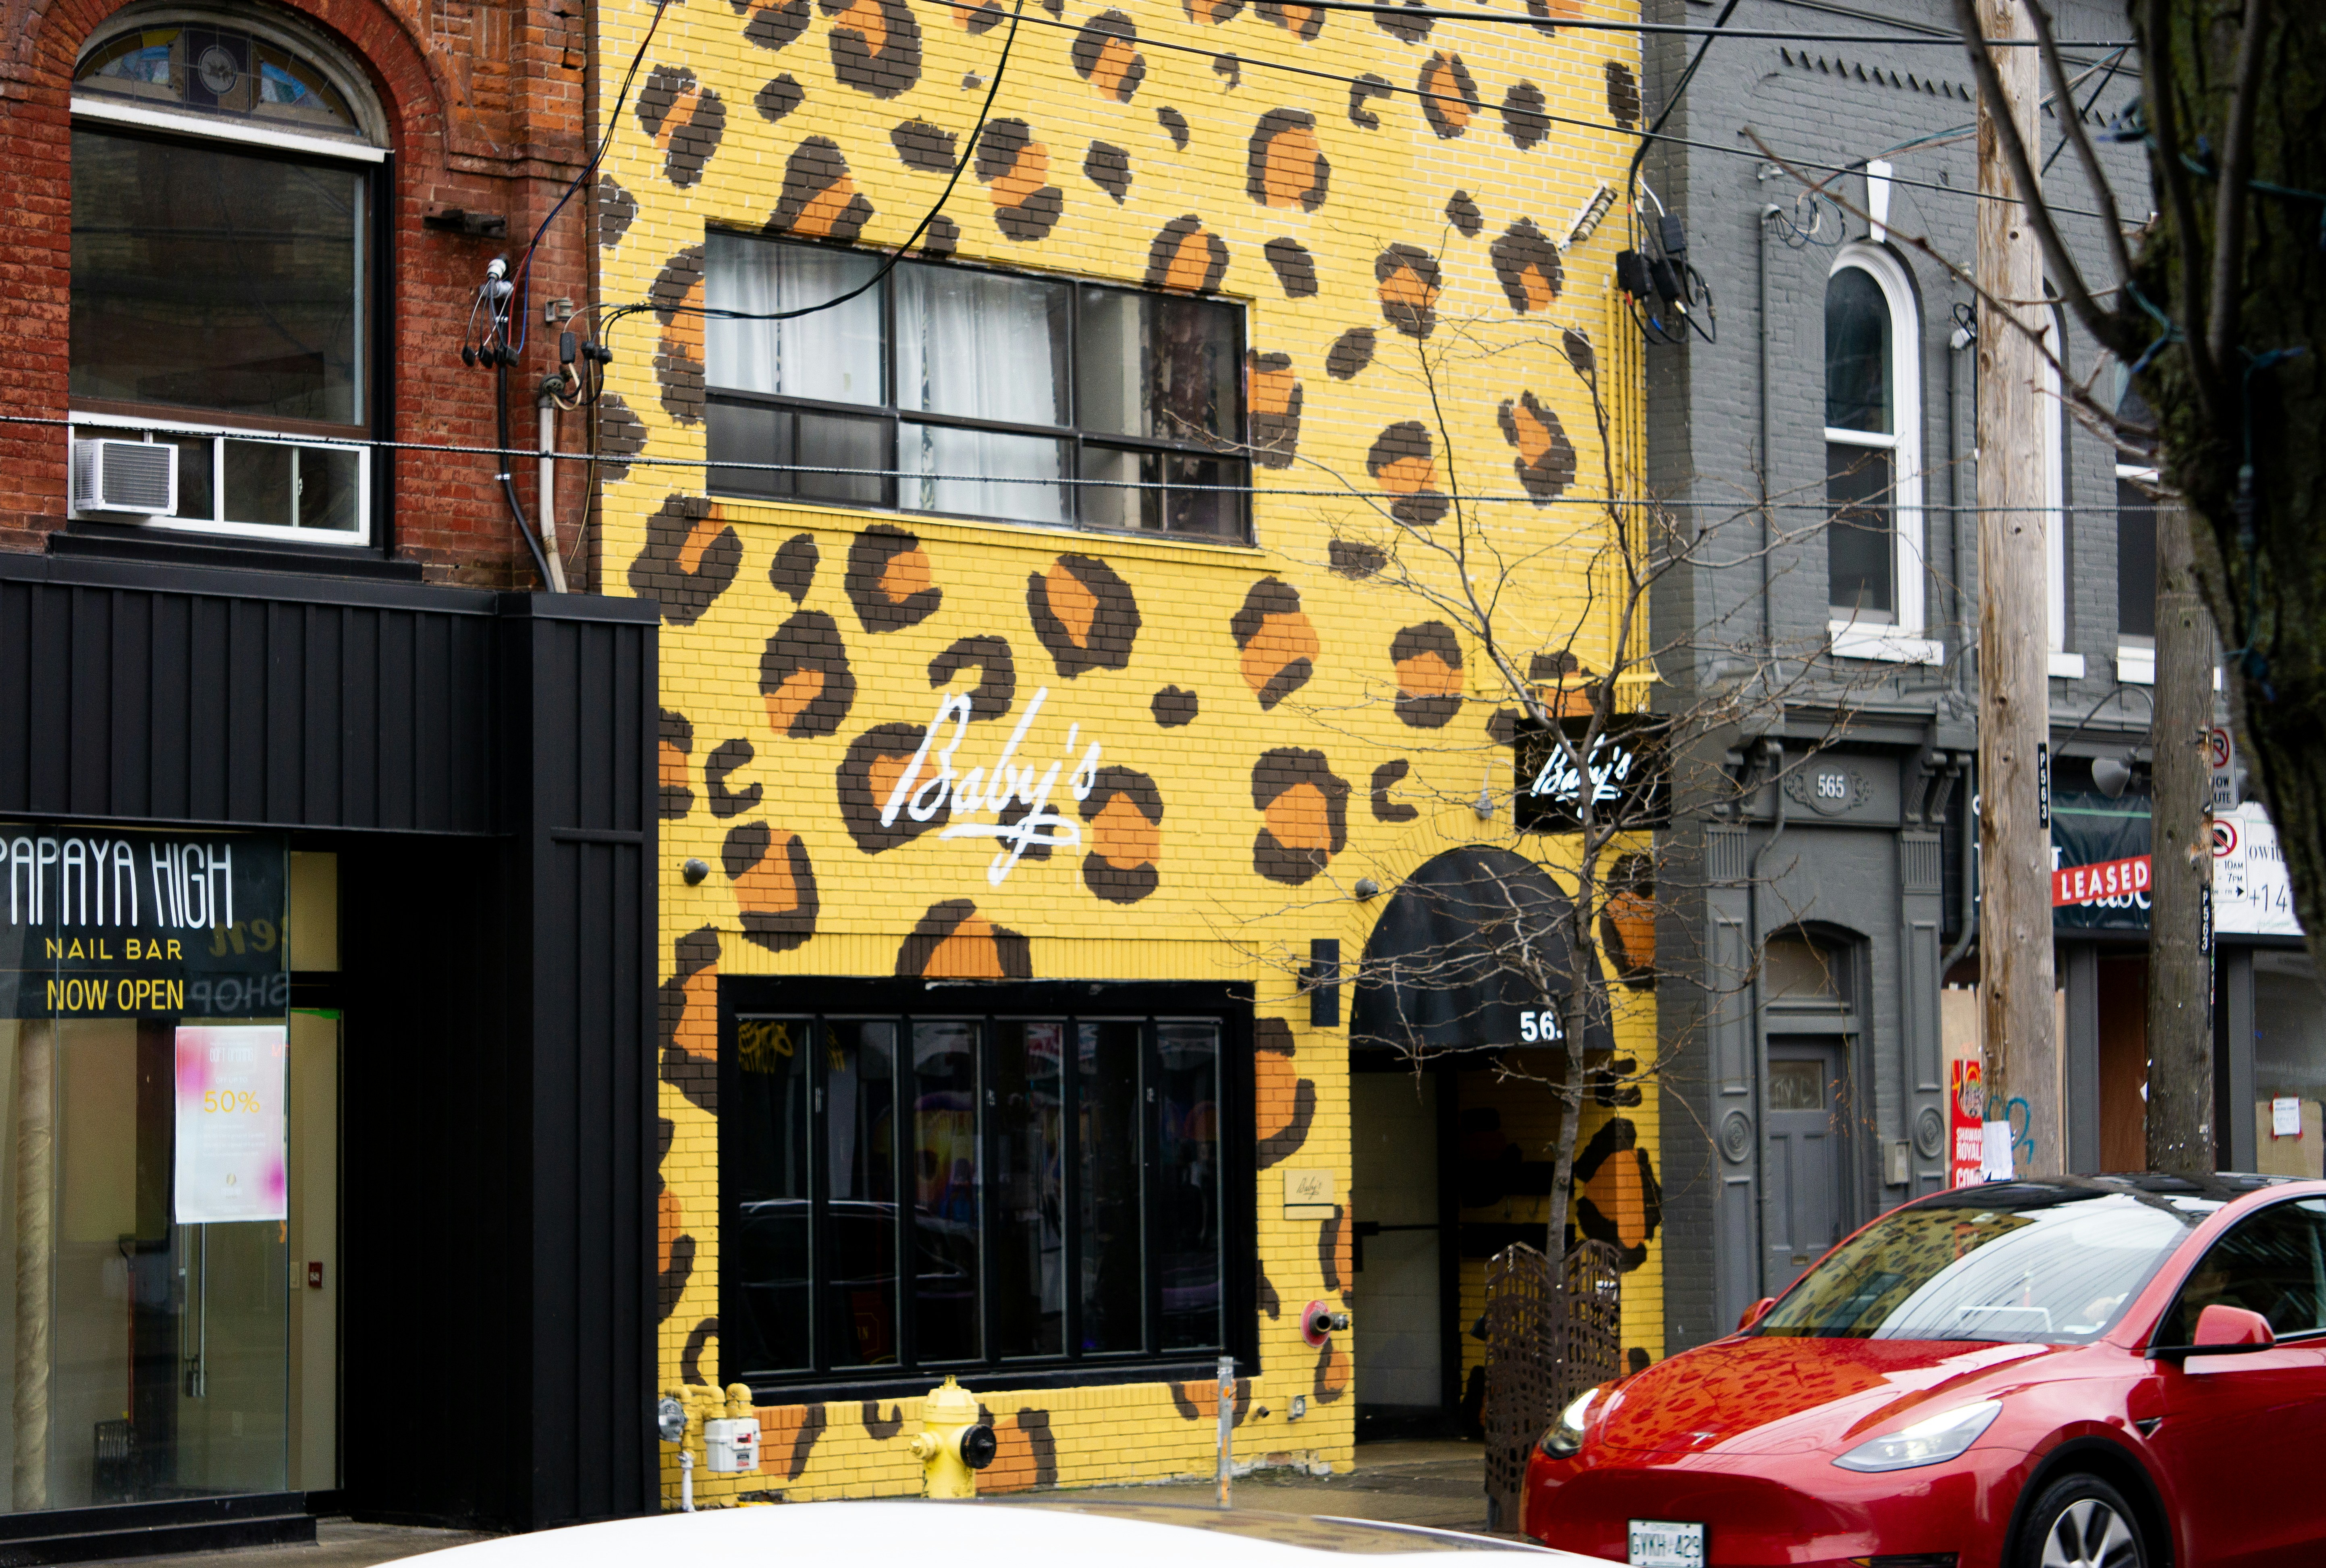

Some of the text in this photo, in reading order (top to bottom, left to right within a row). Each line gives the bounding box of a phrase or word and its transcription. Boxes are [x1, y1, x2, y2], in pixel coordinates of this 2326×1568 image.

[881, 686, 1101, 886] Baby's
[1818, 774, 1845, 799] 565
[2214, 775, 2229, 788] OW
[2214, 792, 2231, 804] UTE
[2224, 859, 2243, 871] 10AM
[151, 842, 233, 929] HIGH
[2061, 860, 2148, 900] LEASED
[2227, 873, 2243, 884] 7PM
[45, 938, 183, 960] NAIL BAR
[48, 979, 183, 1010] NOW OPEN
[1520, 1010, 1564, 1042] 56
[204, 1090, 260, 1113] 50%
[1956, 1126, 1982, 1143] SHAWAR
[1956, 1143, 1982, 1161] ROYAL
